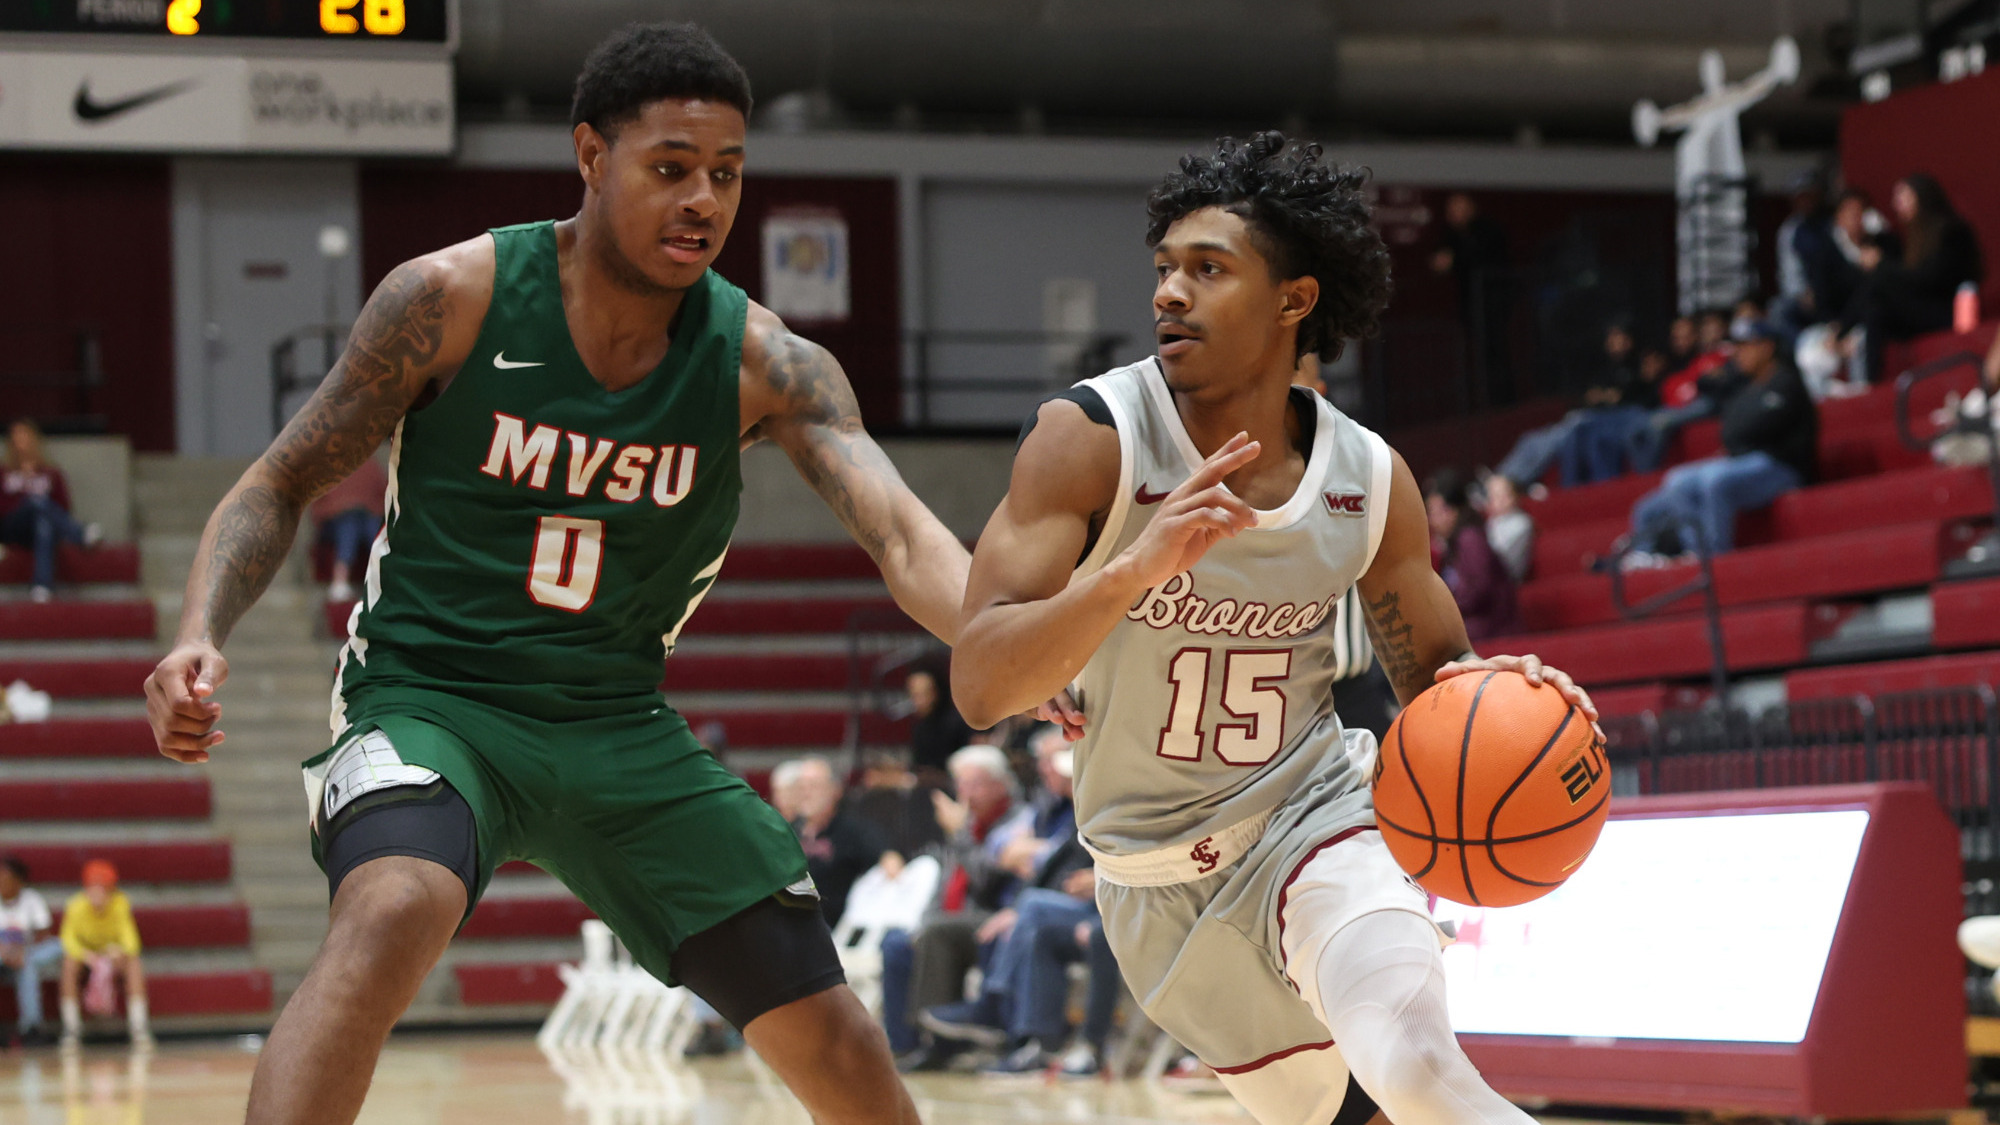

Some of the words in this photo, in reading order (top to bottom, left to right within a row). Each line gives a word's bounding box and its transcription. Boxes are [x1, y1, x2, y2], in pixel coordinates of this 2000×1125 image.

[479, 410, 700, 508] MVSU
[525, 513, 606, 614] 0
[1126, 570, 1336, 639] Broncos
[1156, 646, 1293, 766] 15
